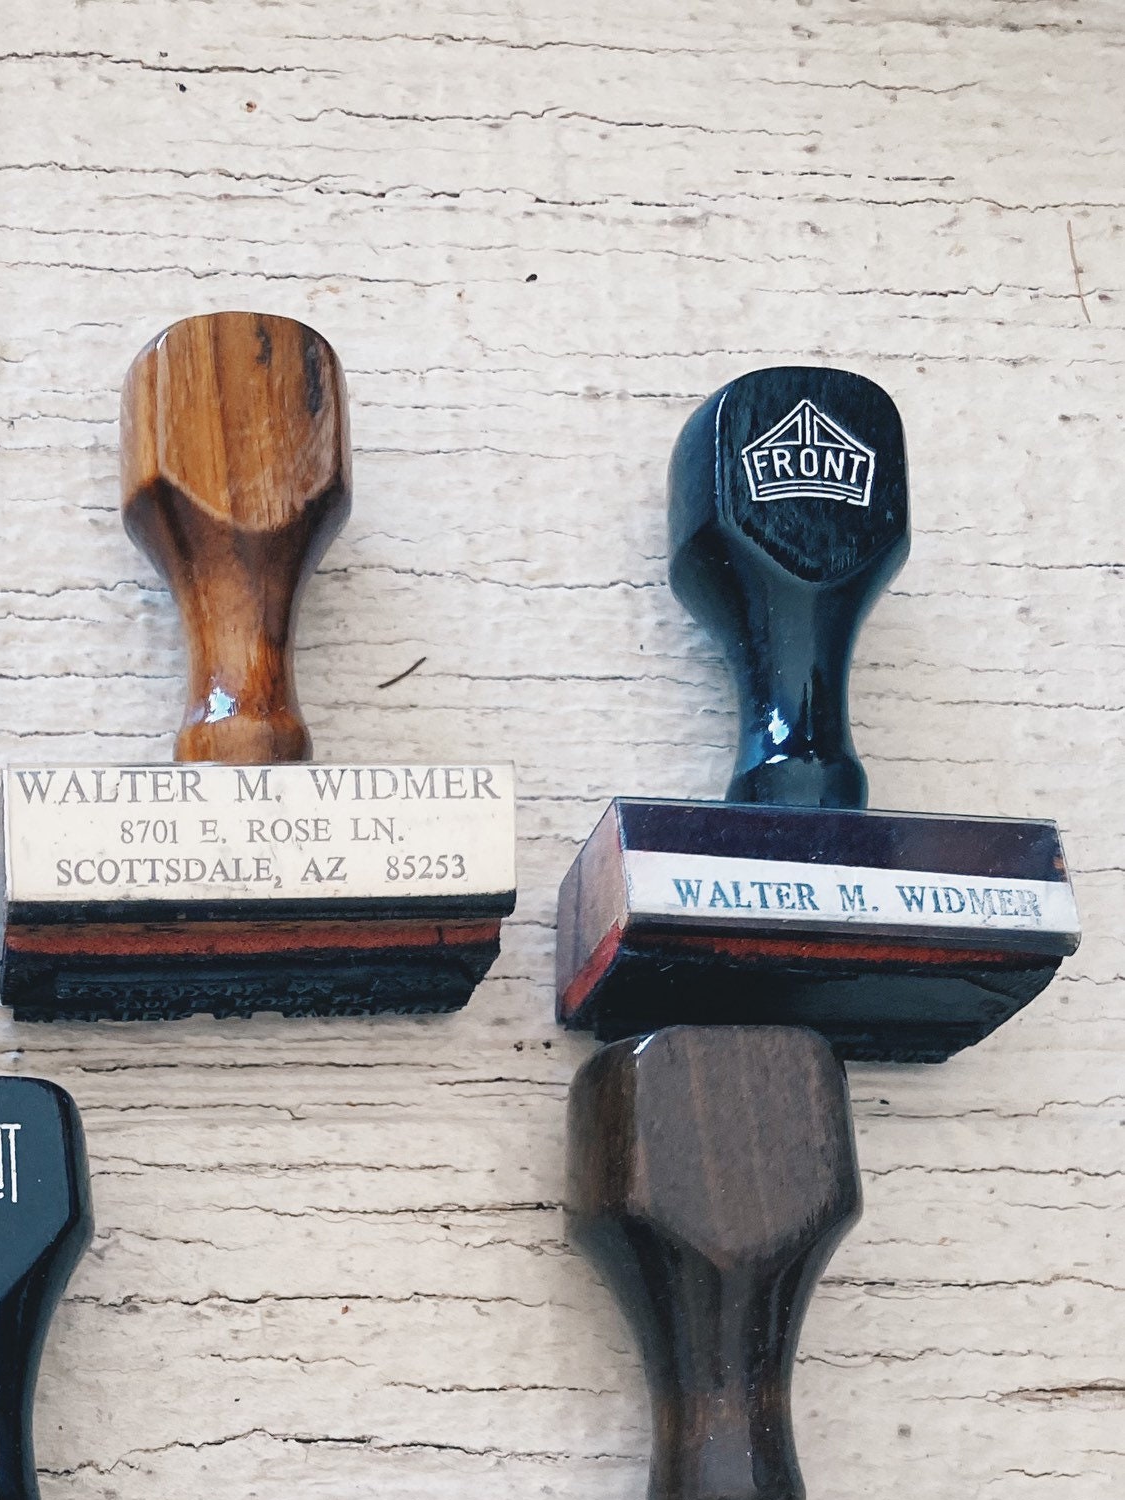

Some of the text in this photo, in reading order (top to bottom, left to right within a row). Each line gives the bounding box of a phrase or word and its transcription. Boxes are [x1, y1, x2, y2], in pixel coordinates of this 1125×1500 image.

[752, 448, 867, 483] FRONT
[17, 767, 502, 806] WALTER M. WIDMER
[120, 817, 405, 845] 8701 E. ROSE LN.
[56, 855, 466, 889] SCOTTSDALE, AZ 85253
[674, 878, 1043, 918] WALTER M. WIDMER
